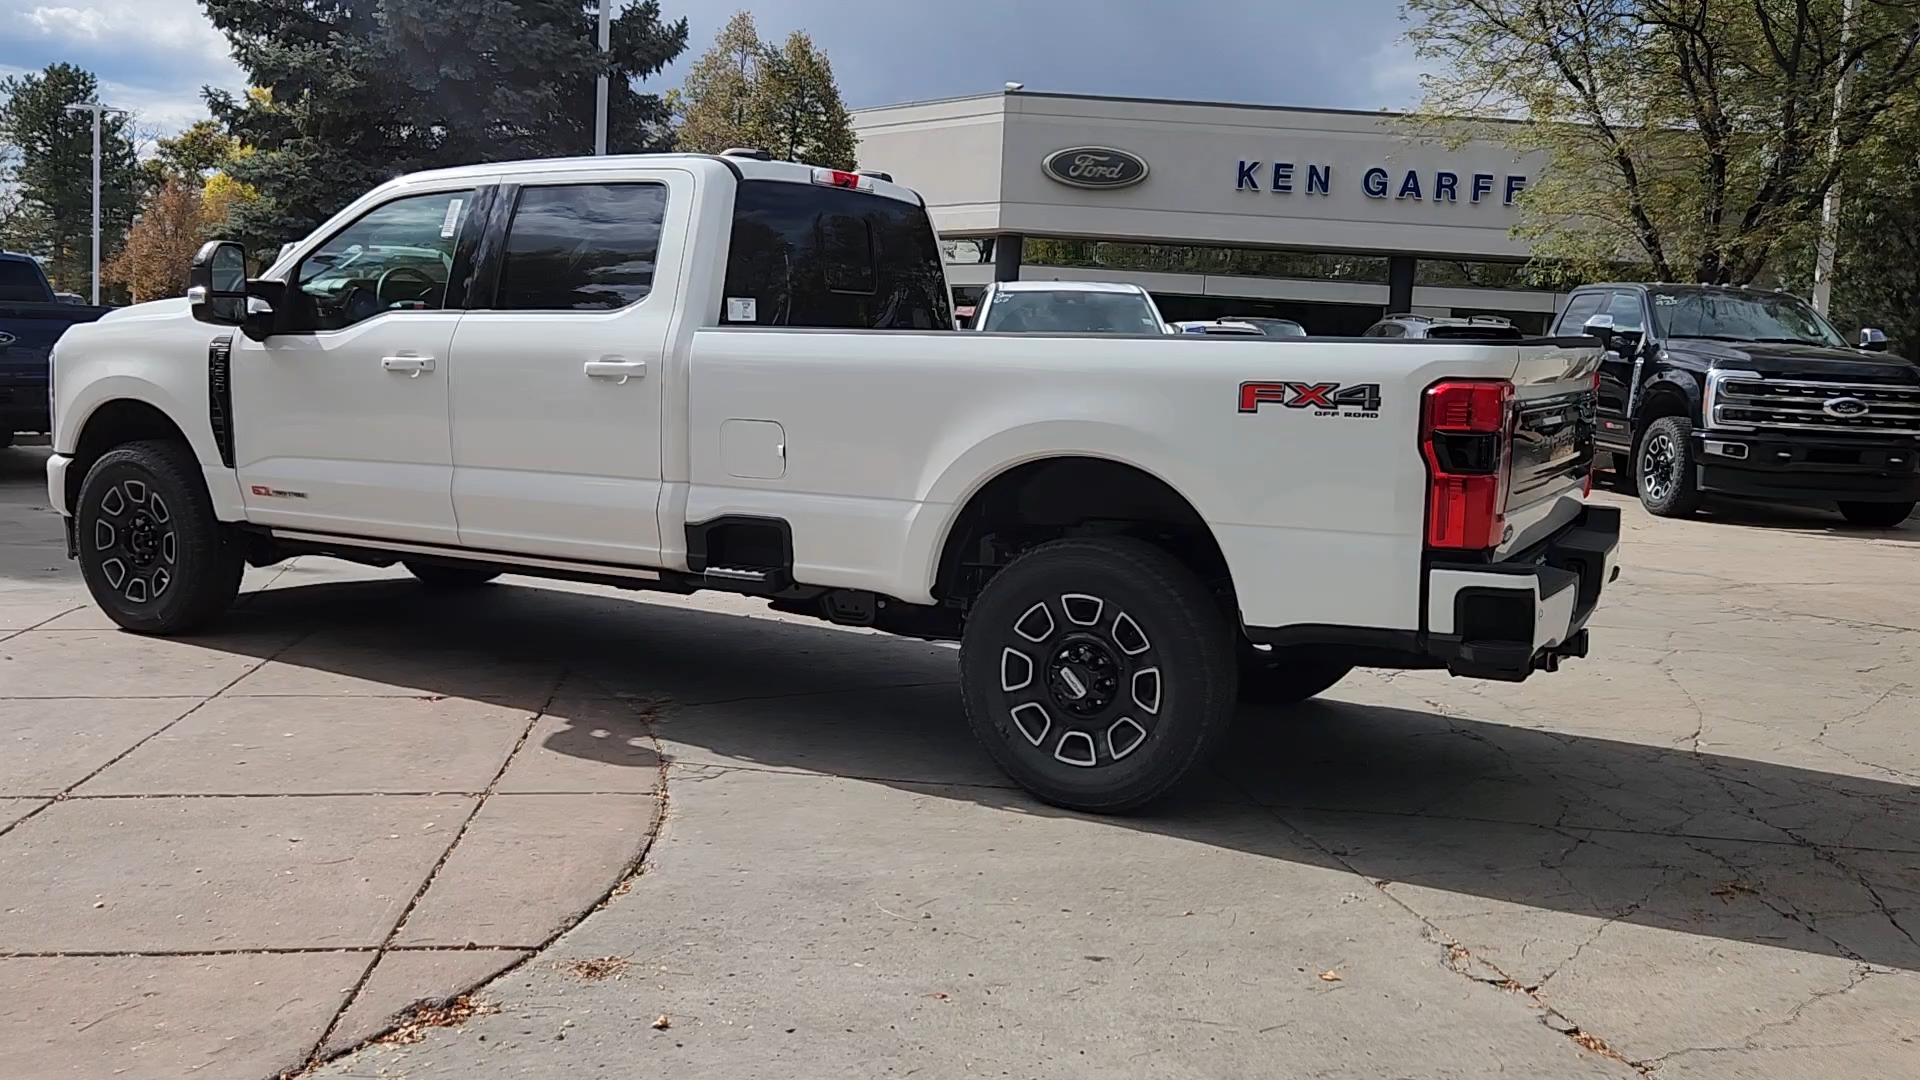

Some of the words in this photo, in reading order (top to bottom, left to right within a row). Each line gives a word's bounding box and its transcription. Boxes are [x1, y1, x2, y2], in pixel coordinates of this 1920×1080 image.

[1068, 153, 1125, 179] Ford
[1236, 160, 1332, 195] KEN
[1362, 167, 1527, 205] GARFF
[1238, 381, 1381, 413] FX4
